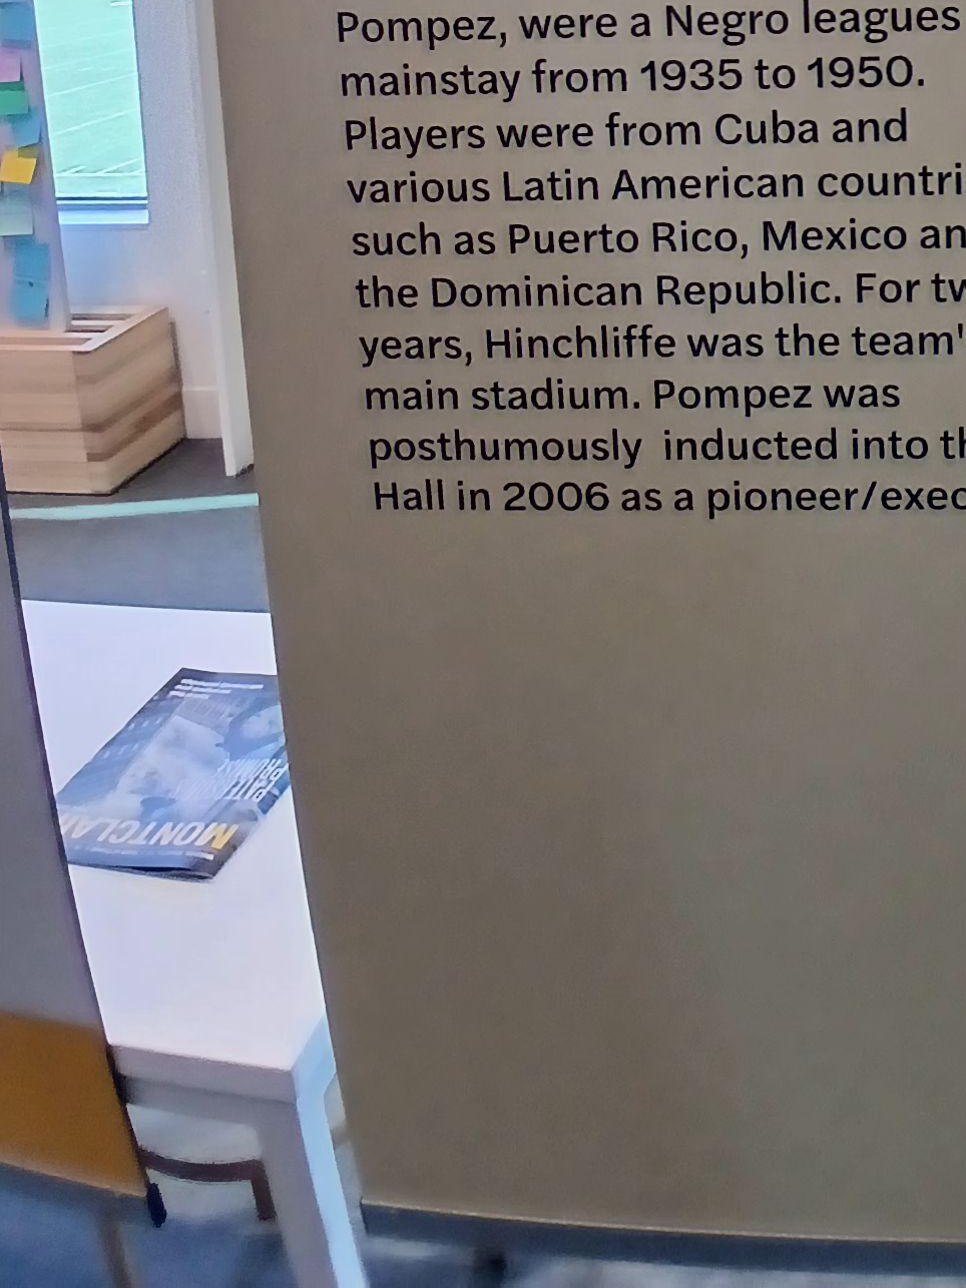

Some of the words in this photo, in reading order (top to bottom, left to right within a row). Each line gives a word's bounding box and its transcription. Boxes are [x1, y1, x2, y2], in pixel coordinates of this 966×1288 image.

[337, 12, 506, 50] Pompez,
[519, 14, 617, 39] were
[631, 13, 651, 37] a
[666, 5, 788, 46] Negro
[803, 0, 960, 43] leagues
[341, 63, 520, 102] mainstay
[532, 59, 627, 93] from
[641, 59, 742, 91] 1935
[754, 59, 795, 89] to
[808, 55, 924, 88] 1950.
[346, 116, 485, 158] Players
[496, 123, 593, 147] were
[605, 112, 700, 146] from
[715, 110, 819, 144] Cuba
[833, 107, 907, 143] and
[347, 171, 490, 203] various
[503, 169, 598, 201] Latin
[612, 166, 803, 200] American
[352, 222, 441, 256] such
[455, 231, 495, 255] as
[509, 224, 638, 254] Puerto
[653, 220, 747, 259] Rico,
[763, 218, 906, 251] Mexico
[355, 275, 418, 308] the
[432, 275, 641, 307] Dominican
[657, 270, 840, 314] Republic.
[857, 273, 920, 303] For
[359, 336, 471, 367] years,
[486, 324, 675, 358] Hinchliffe
[687, 334, 763, 357] was
[775, 323, 839, 356] the
[366, 379, 458, 410] main
[472, 377, 639, 410] stadium.
[654, 380, 812, 417] Pompez
[823, 385, 900, 408] was
[370, 428, 642, 469] posthumously
[664, 427, 837, 460] inducted
[852, 429, 928, 459] into
[374, 479, 444, 510] Hall
[458, 481, 490, 511] in
[503, 482, 609, 511] 2006
[622, 489, 662, 511] as
[674, 489, 693, 511] a
